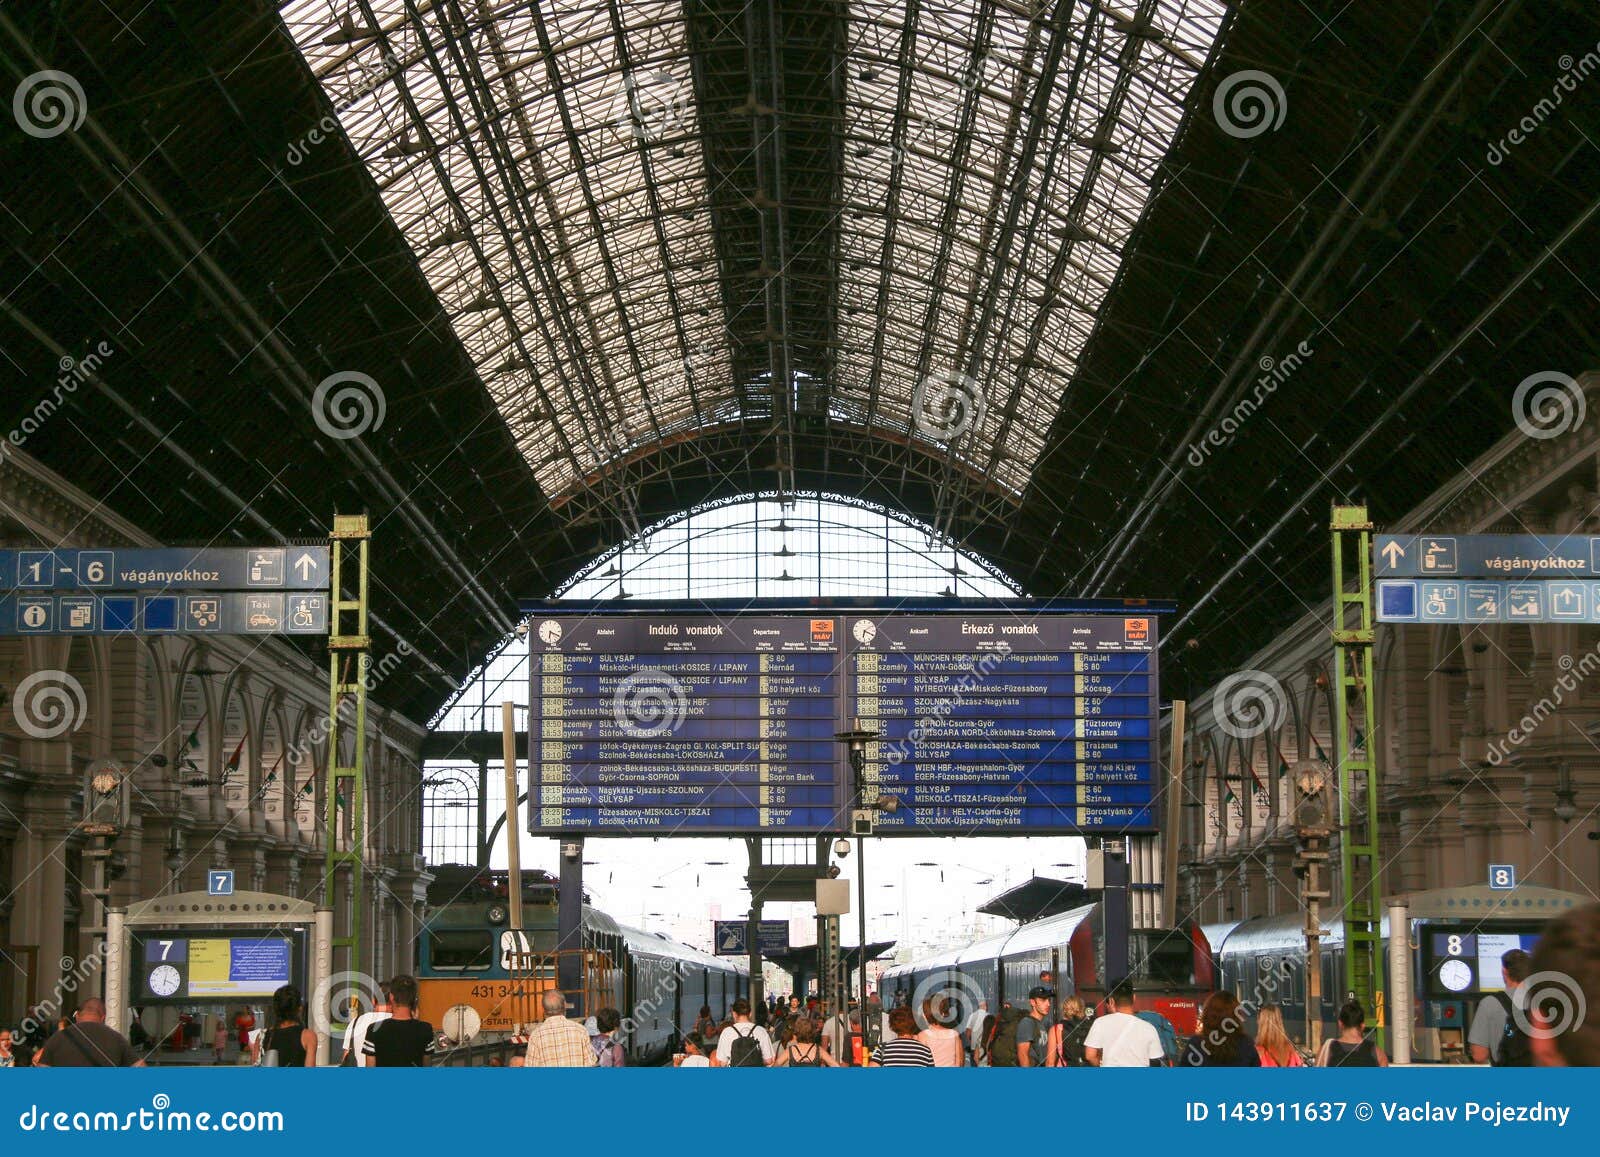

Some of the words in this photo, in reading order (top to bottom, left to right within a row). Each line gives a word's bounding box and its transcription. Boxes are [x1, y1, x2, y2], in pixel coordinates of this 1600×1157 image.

[1485, 556, 1585, 571] vágányokhoz
[28, 562, 41, 582] 1
[87, 561, 104, 582] 6
[120, 568, 220, 587] vágányokhoz
[251, 600, 270, 609] Taxi
[649, 624, 679, 636] Induló
[685, 624, 723, 636] vonatok
[753, 629, 780, 637] Departures
[961, 621, 994, 635] Érkező
[1001, 624, 1039, 635] vonatok
[914, 654, 952, 662] MÜNCHEN
[719, 664, 748, 672] LIPANY
[719, 676, 748, 684] LIPANY
[914, 676, 950, 684] SÜLYSÁP
[915, 764, 936, 772] WIEN
[769, 774, 794, 782] Sopron
[769, 808, 792, 816] Hámor
[215, 876, 228, 891] 7
[1495, 870, 1508, 885] 8
[159, 941, 173, 960] 7
[1447, 935, 1462, 956] 8
[471, 985, 494, 998] 431
